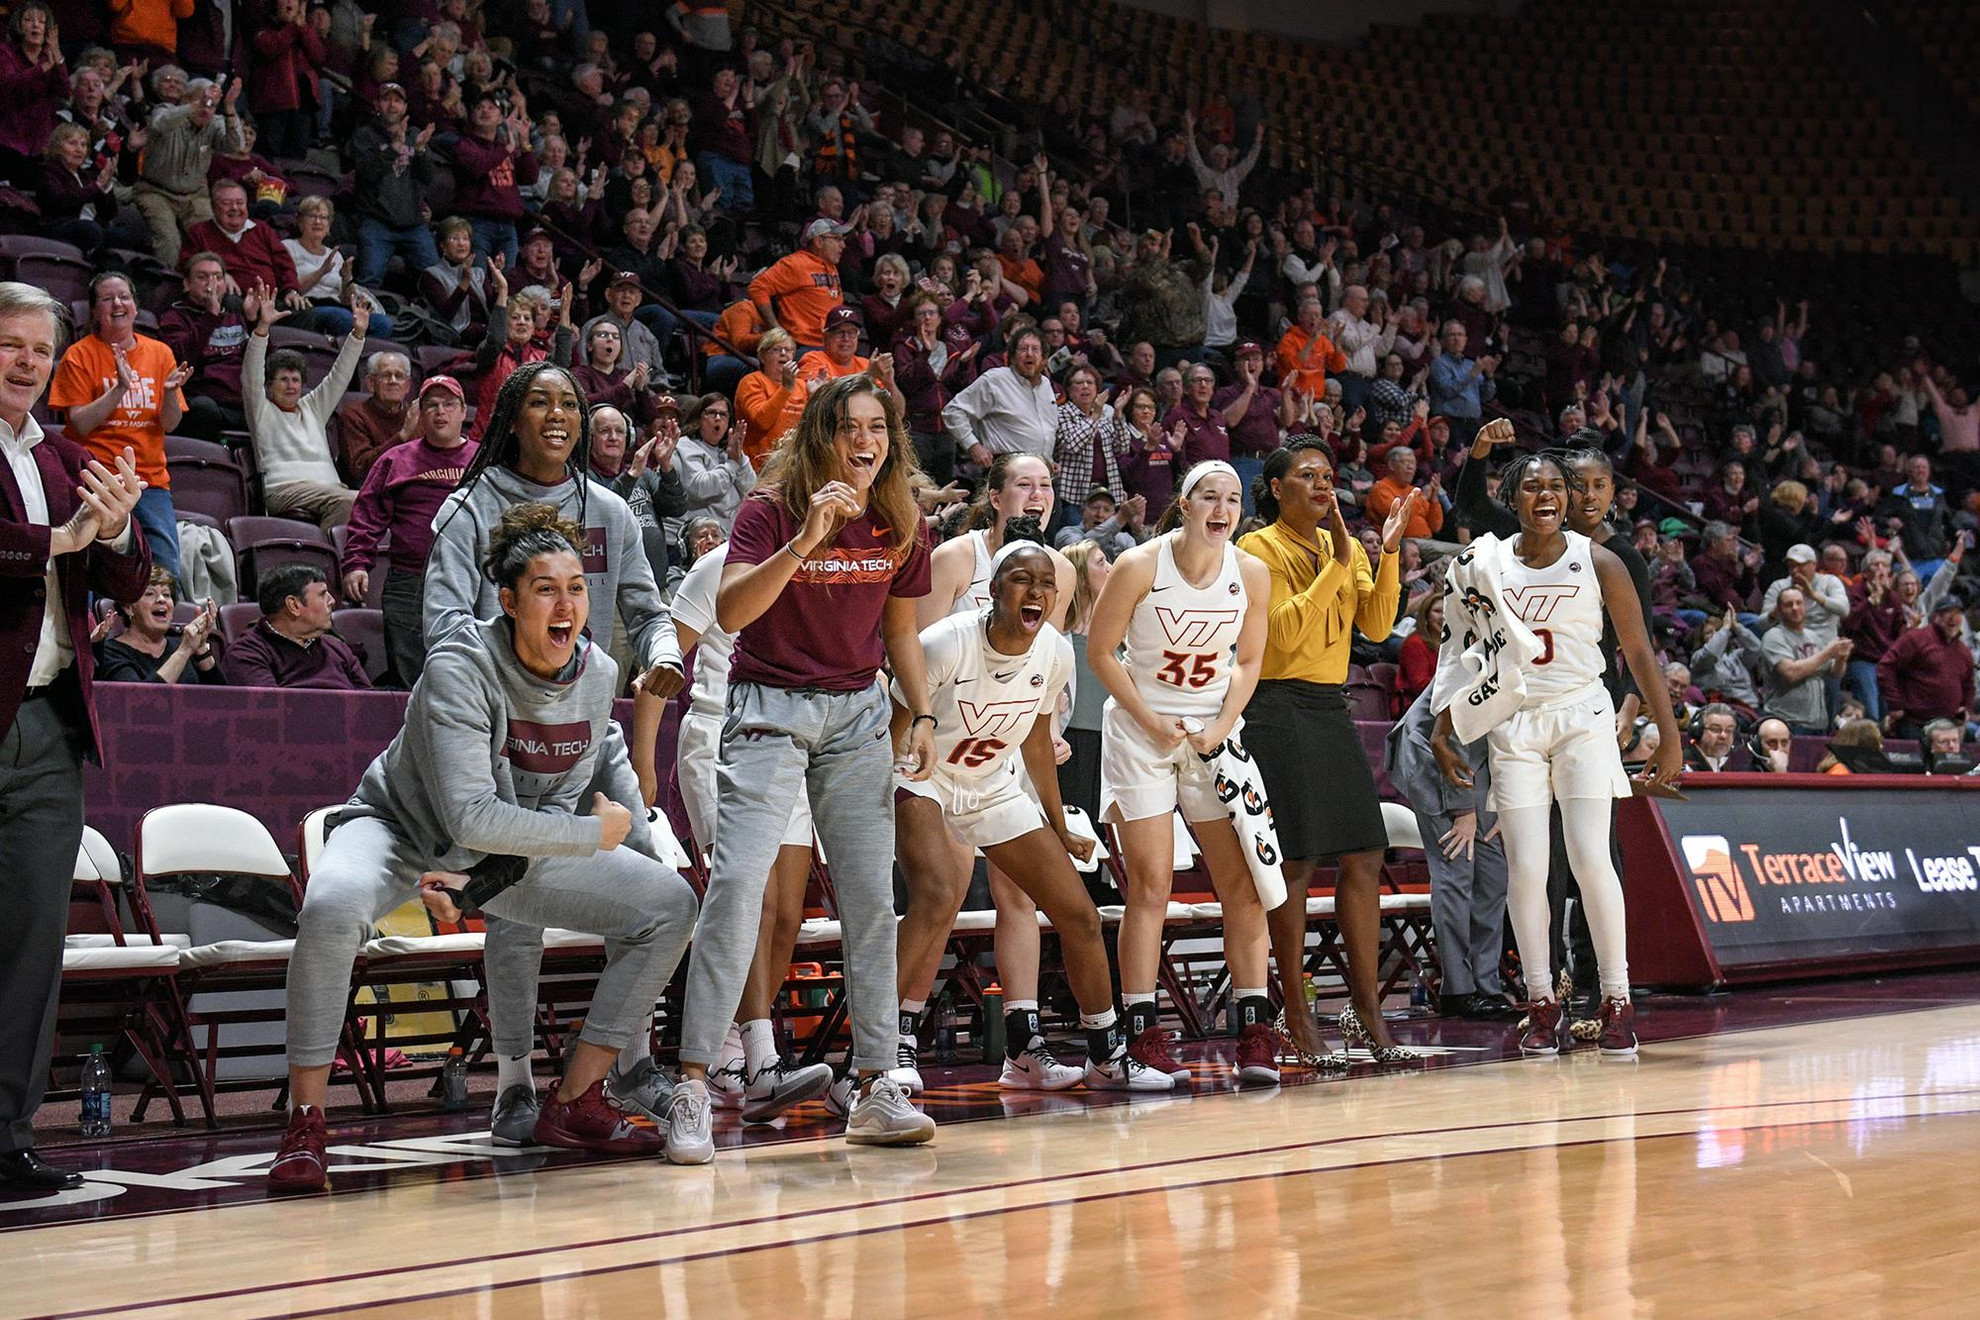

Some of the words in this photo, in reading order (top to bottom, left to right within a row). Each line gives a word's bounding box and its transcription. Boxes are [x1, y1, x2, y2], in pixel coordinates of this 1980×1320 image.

[838, 309, 854, 318] VT
[800, 560, 860, 572] VIRGINIA
[861, 559, 893, 571] TECH
[1154, 606, 1239, 648] VT
[1156, 649, 1219, 689] 35
[957, 697, 1041, 737] VT
[551, 739, 590, 756] TECH
[945, 736, 1009, 768] 15
[1740, 816, 1897, 885] TerraceView
[1905, 847, 1978, 893] Lease
[1779, 891, 1897, 914] APARTMENTS
